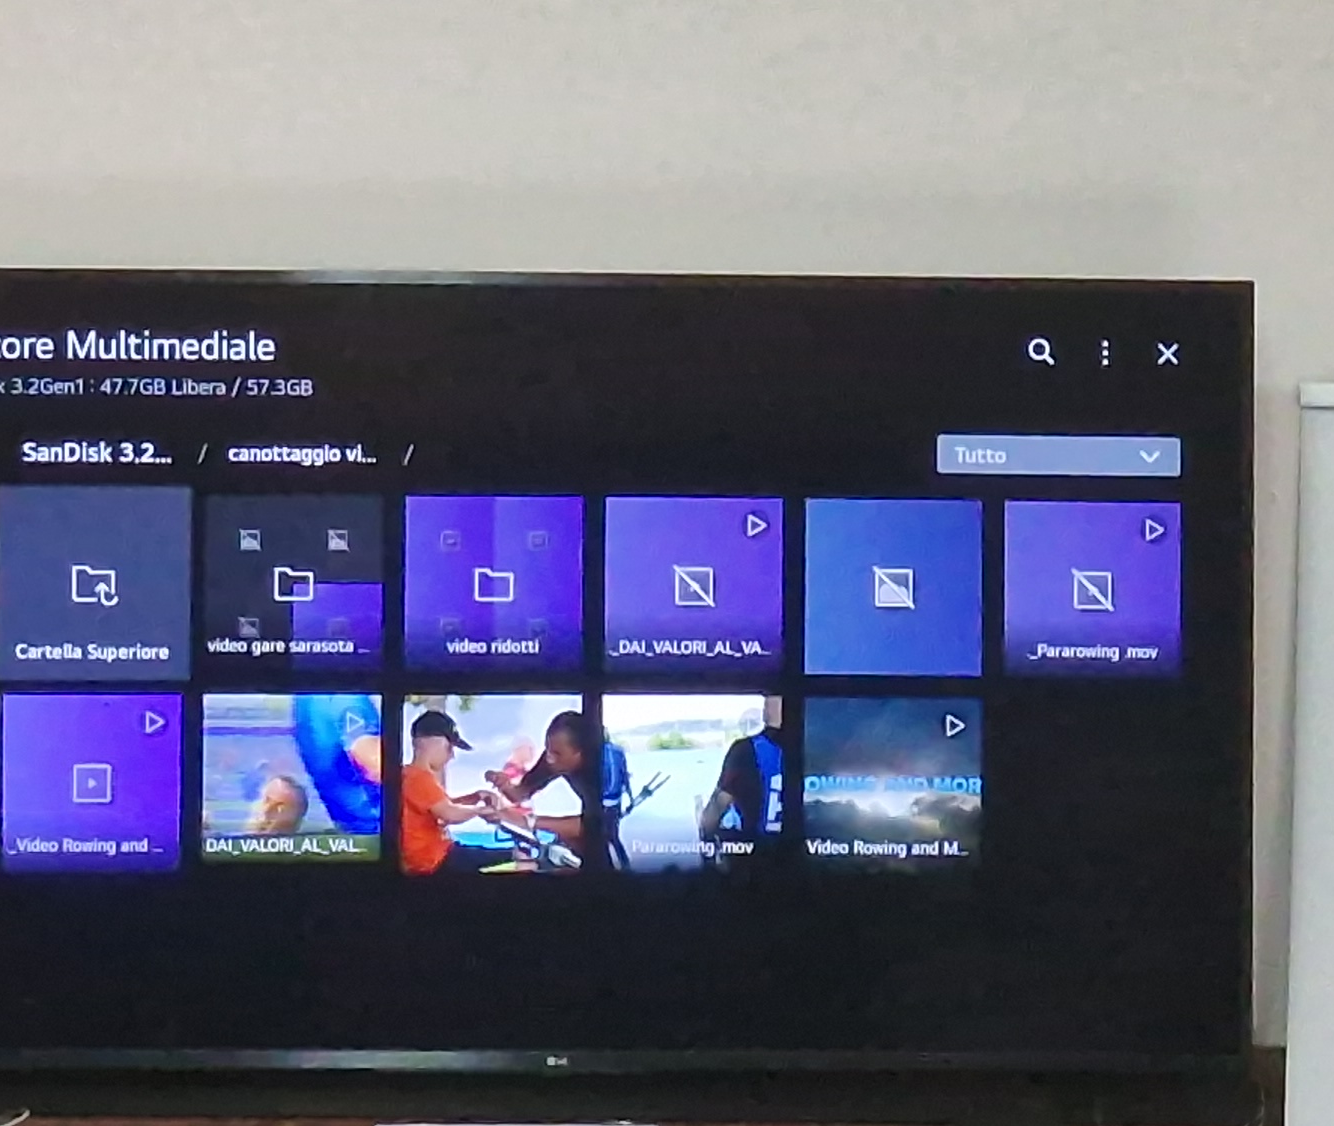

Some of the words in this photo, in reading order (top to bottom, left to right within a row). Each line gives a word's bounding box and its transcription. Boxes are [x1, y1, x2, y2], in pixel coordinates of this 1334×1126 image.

[66, 329, 276, 362] Multimediale
[11, 377, 85, 396] 3.2Gen1
[99, 378, 167, 397] 47.7GB
[171, 377, 227, 396] Libera
[246, 379, 314, 397] 57.3GB
[22, 441, 114, 463] SanDisk
[227, 445, 341, 467] canottaggio
[954, 446, 1007, 466] Tutto
[15, 642, 83, 660] Cartella
[86, 643, 170, 663] Superiore
[207, 638, 248, 654] video
[251, 641, 286, 657] gare
[288, 640, 355, 654] sarasota
[446, 638, 488, 654] video
[490, 638, 541, 654] ridotti
[62, 838, 118, 857] Rowing
[120, 838, 149, 853] and
[631, 839, 716, 858] Pararowing
[806, 839, 850, 856] Video
[852, 840, 908, 858] Rowing
[910, 840, 939, 856] and
